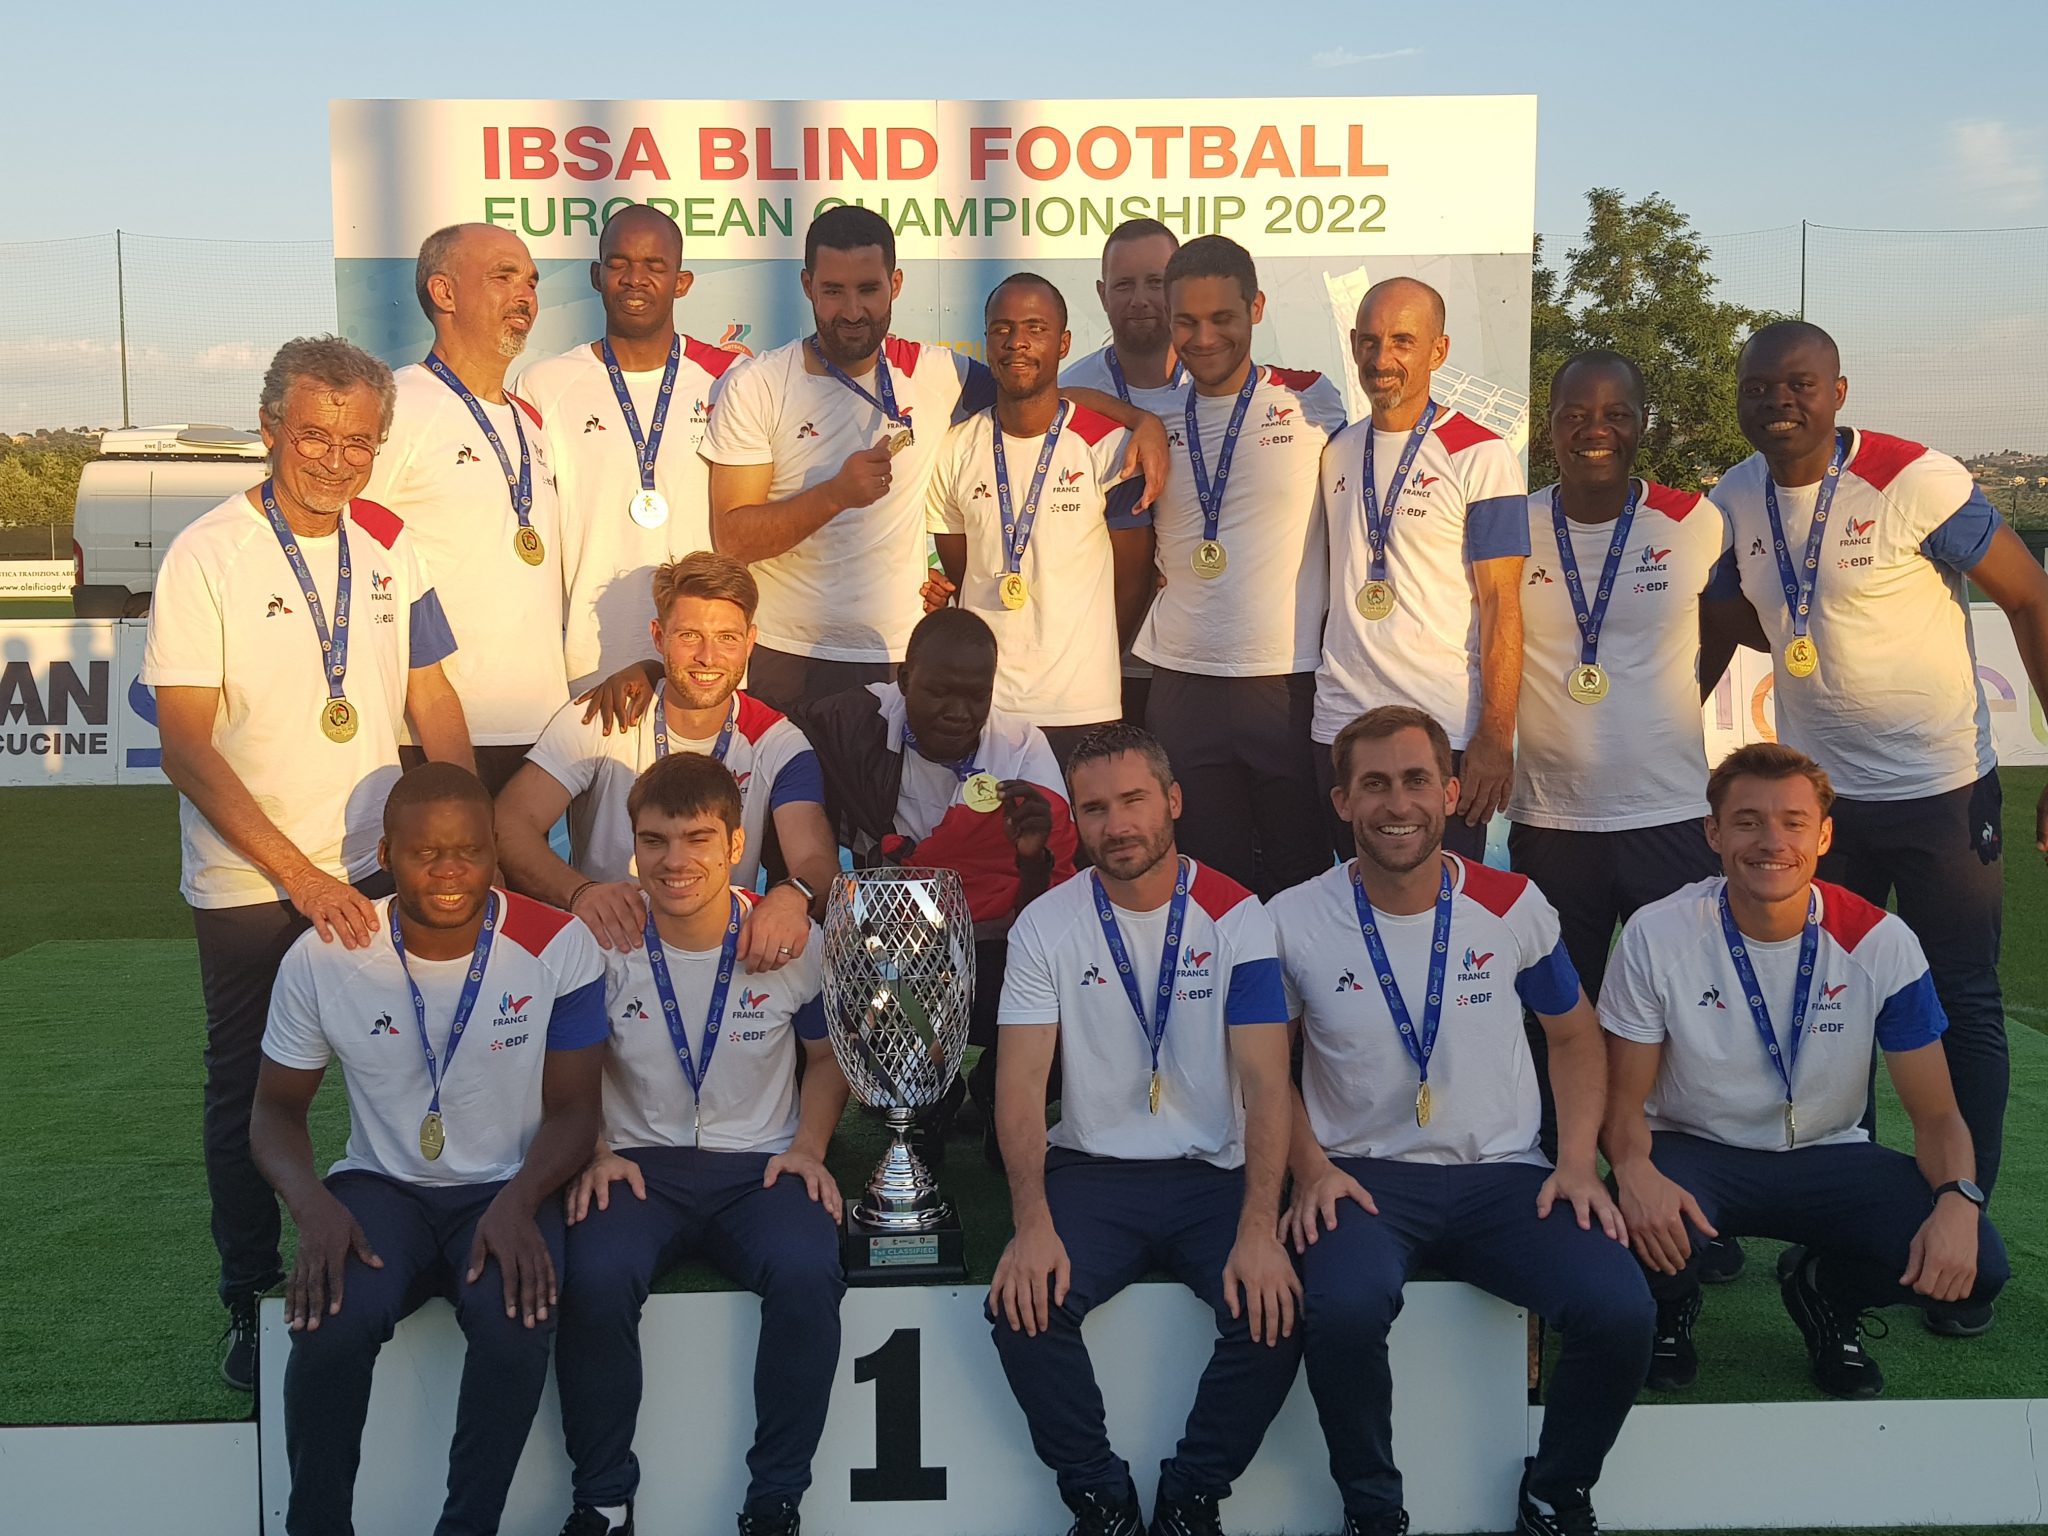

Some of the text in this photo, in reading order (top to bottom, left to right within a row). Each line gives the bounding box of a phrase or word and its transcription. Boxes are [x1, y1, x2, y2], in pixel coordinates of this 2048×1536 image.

[483, 124, 1388, 181] IBSA BLIND FOOTBALL
[1264, 195, 1386, 234] 2022
[1402, 488, 1431, 498] FRANCE
[1839, 537, 1872, 547] FRANCE
[1635, 564, 1667, 574] FRANCE
[0, 733, 107, 756] UCINE
[1176, 969, 1209, 977] FRANCE
[1457, 971, 1490, 981] FRANCE
[732, 1011, 765, 1019] FRANCE
[493, 1015, 528, 1026] FRANCE
[850, 1328, 947, 1502] 1
